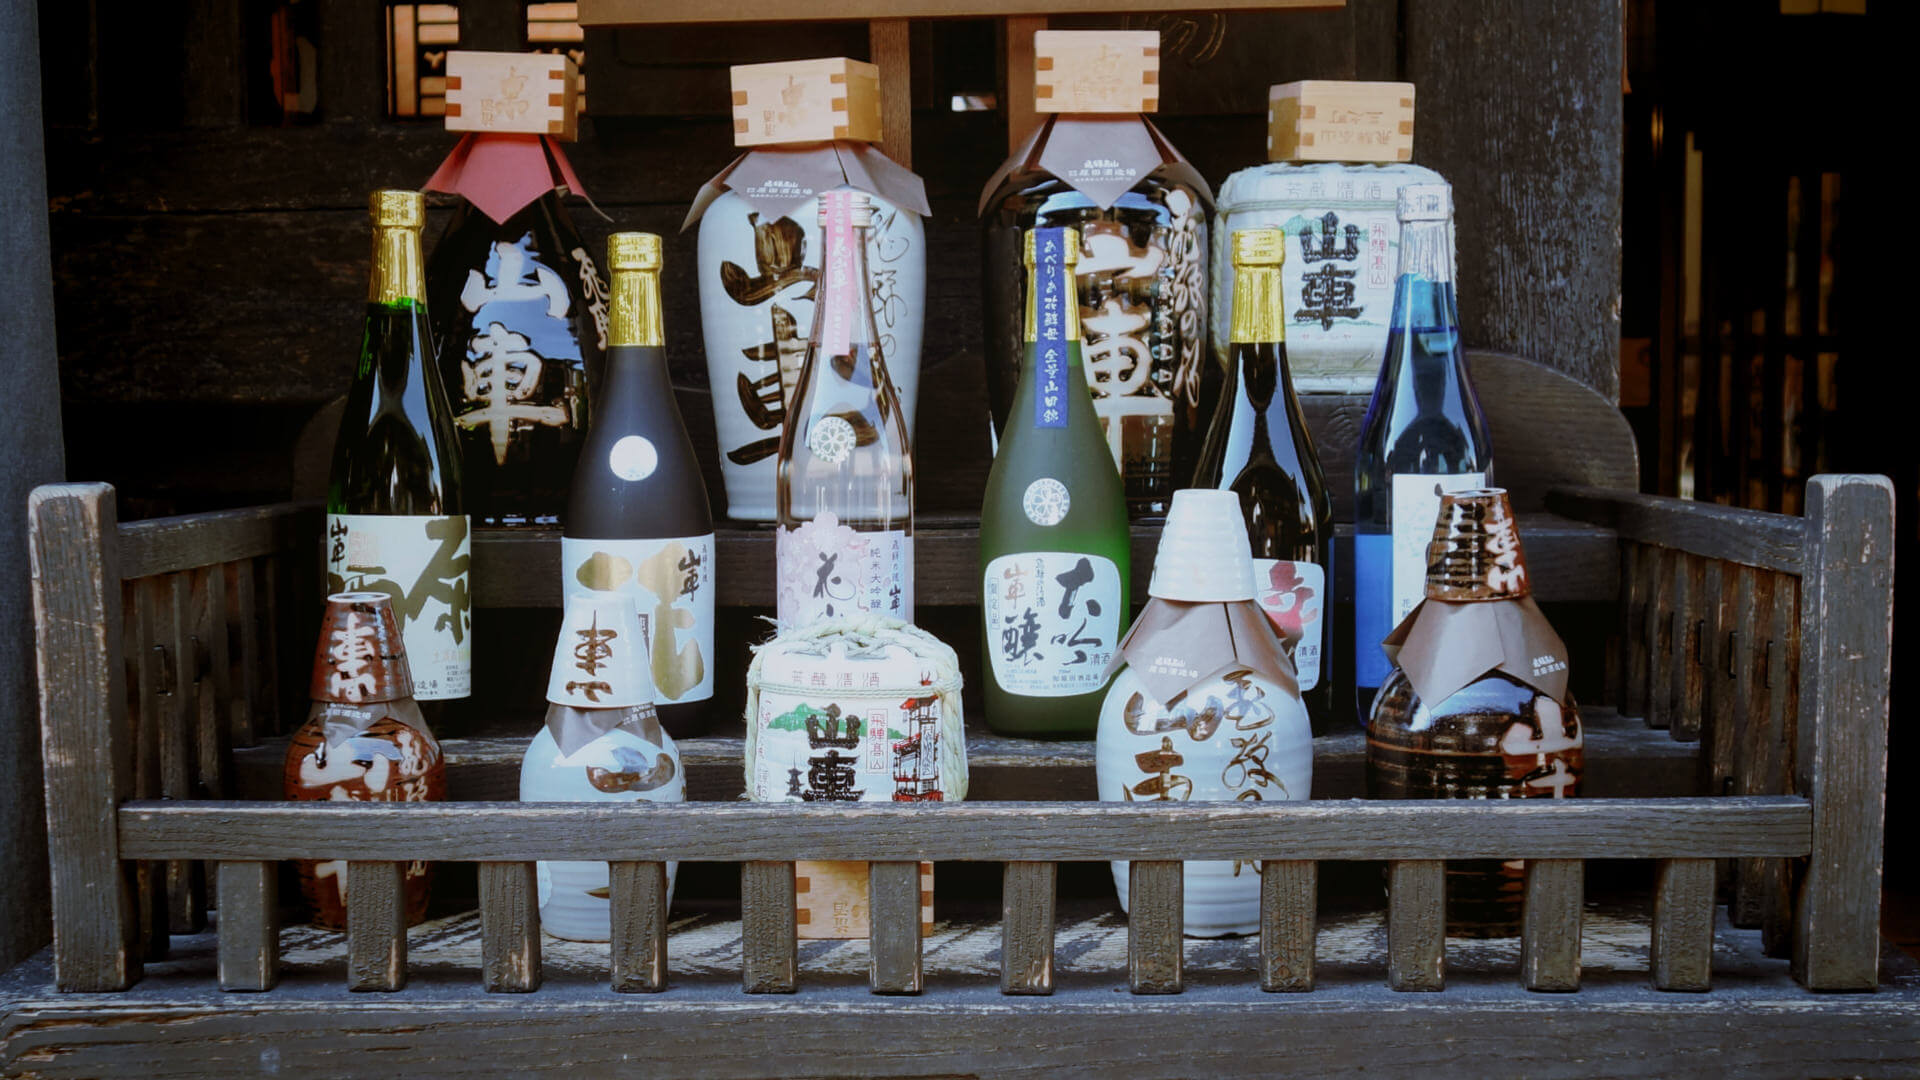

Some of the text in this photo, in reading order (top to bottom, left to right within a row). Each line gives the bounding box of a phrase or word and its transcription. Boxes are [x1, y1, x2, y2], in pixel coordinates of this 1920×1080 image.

[1294, 211, 1364, 331] 山車
[454, 241, 571, 466] 山車
[330, 517, 348, 572] 山車
[678, 549, 701, 602] 山車
[889, 585, 901, 614] 山車
[566, 610, 618, 703] 山車
[1090, 653, 1112, 665] 清酒
[801, 703, 866, 801] 山車
[870, 713, 886, 771] 飛騨高山
